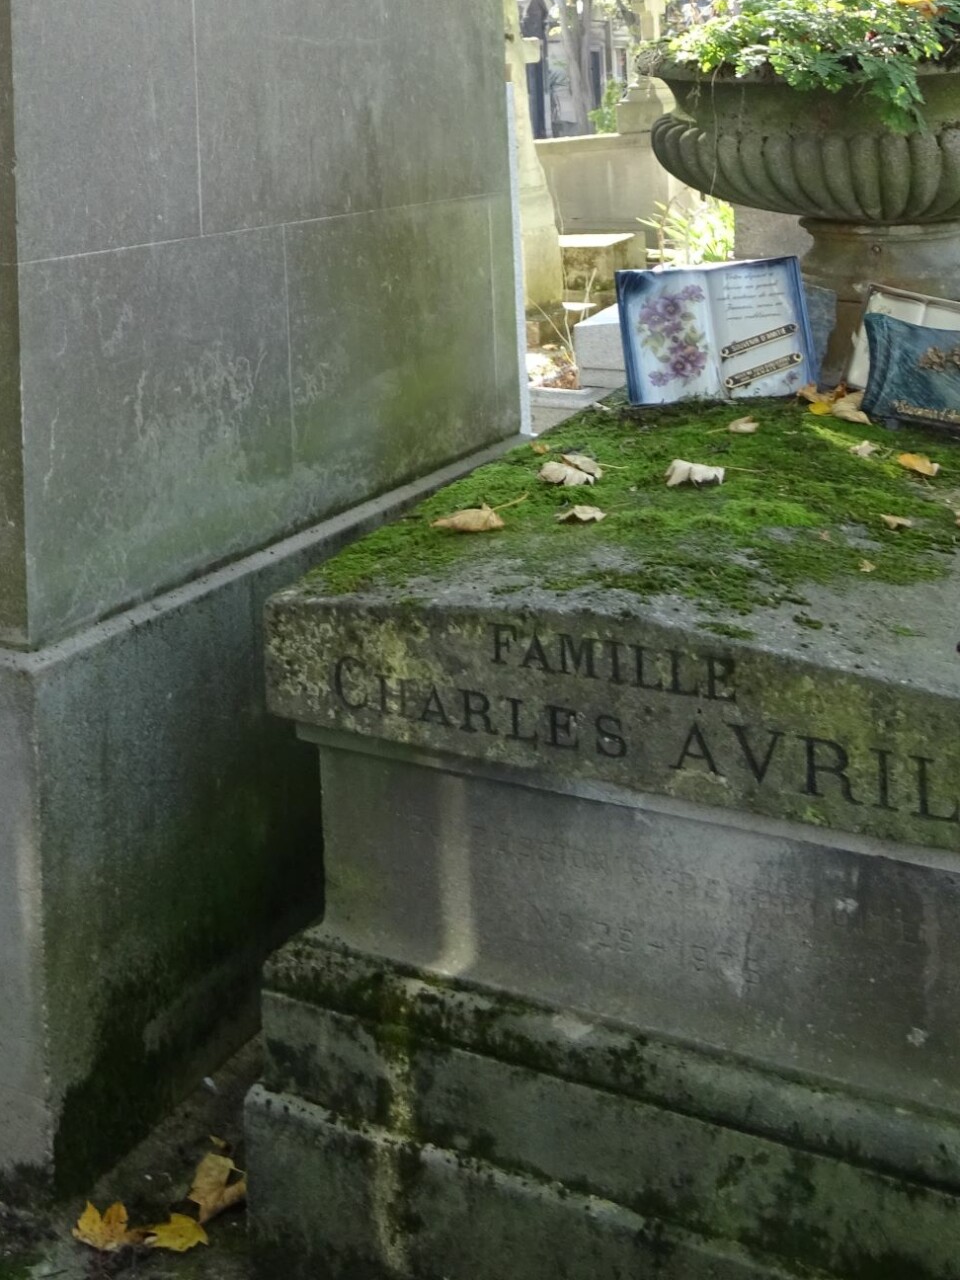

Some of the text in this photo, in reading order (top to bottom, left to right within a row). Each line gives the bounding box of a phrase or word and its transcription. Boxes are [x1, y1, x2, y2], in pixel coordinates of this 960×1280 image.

[491, 621, 737, 703] FAMILLE
[335, 655, 960, 822] CHARLES AVRIL
